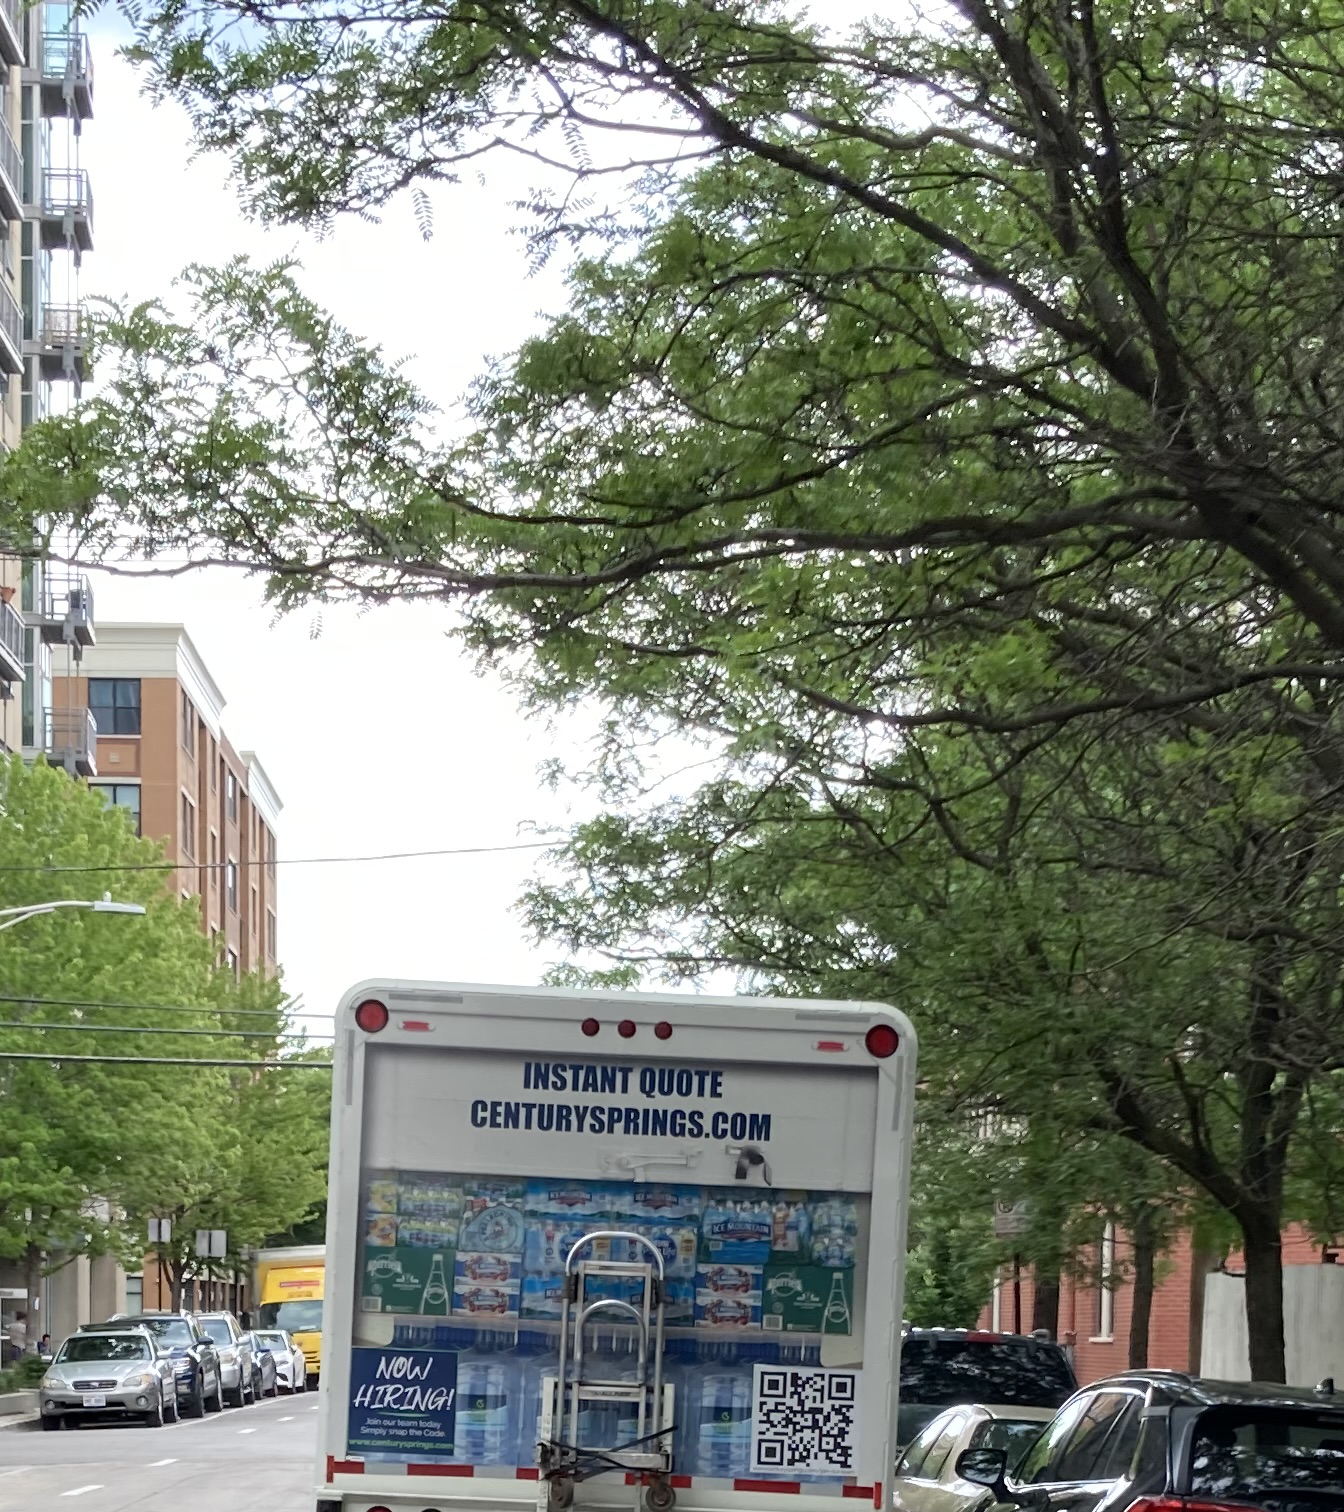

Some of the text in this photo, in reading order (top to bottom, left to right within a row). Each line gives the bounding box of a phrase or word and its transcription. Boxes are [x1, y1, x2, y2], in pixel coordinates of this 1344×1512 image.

[523, 1061, 723, 1099] INSTANT QUOTE
[470, 1099, 772, 1142] CENTURYSPRINGS.COM
[376, 1356, 433, 1381] NOW
[353, 1383, 455, 1411] HIRING!
[360, 1426, 387, 1436] Simply
[388, 1428, 408, 1437] snap
[408, 1427, 423, 1437] the
[365, 1417, 382, 1426] Join
[382, 1419, 397, 1427] our
[397, 1418, 418, 1427] team
